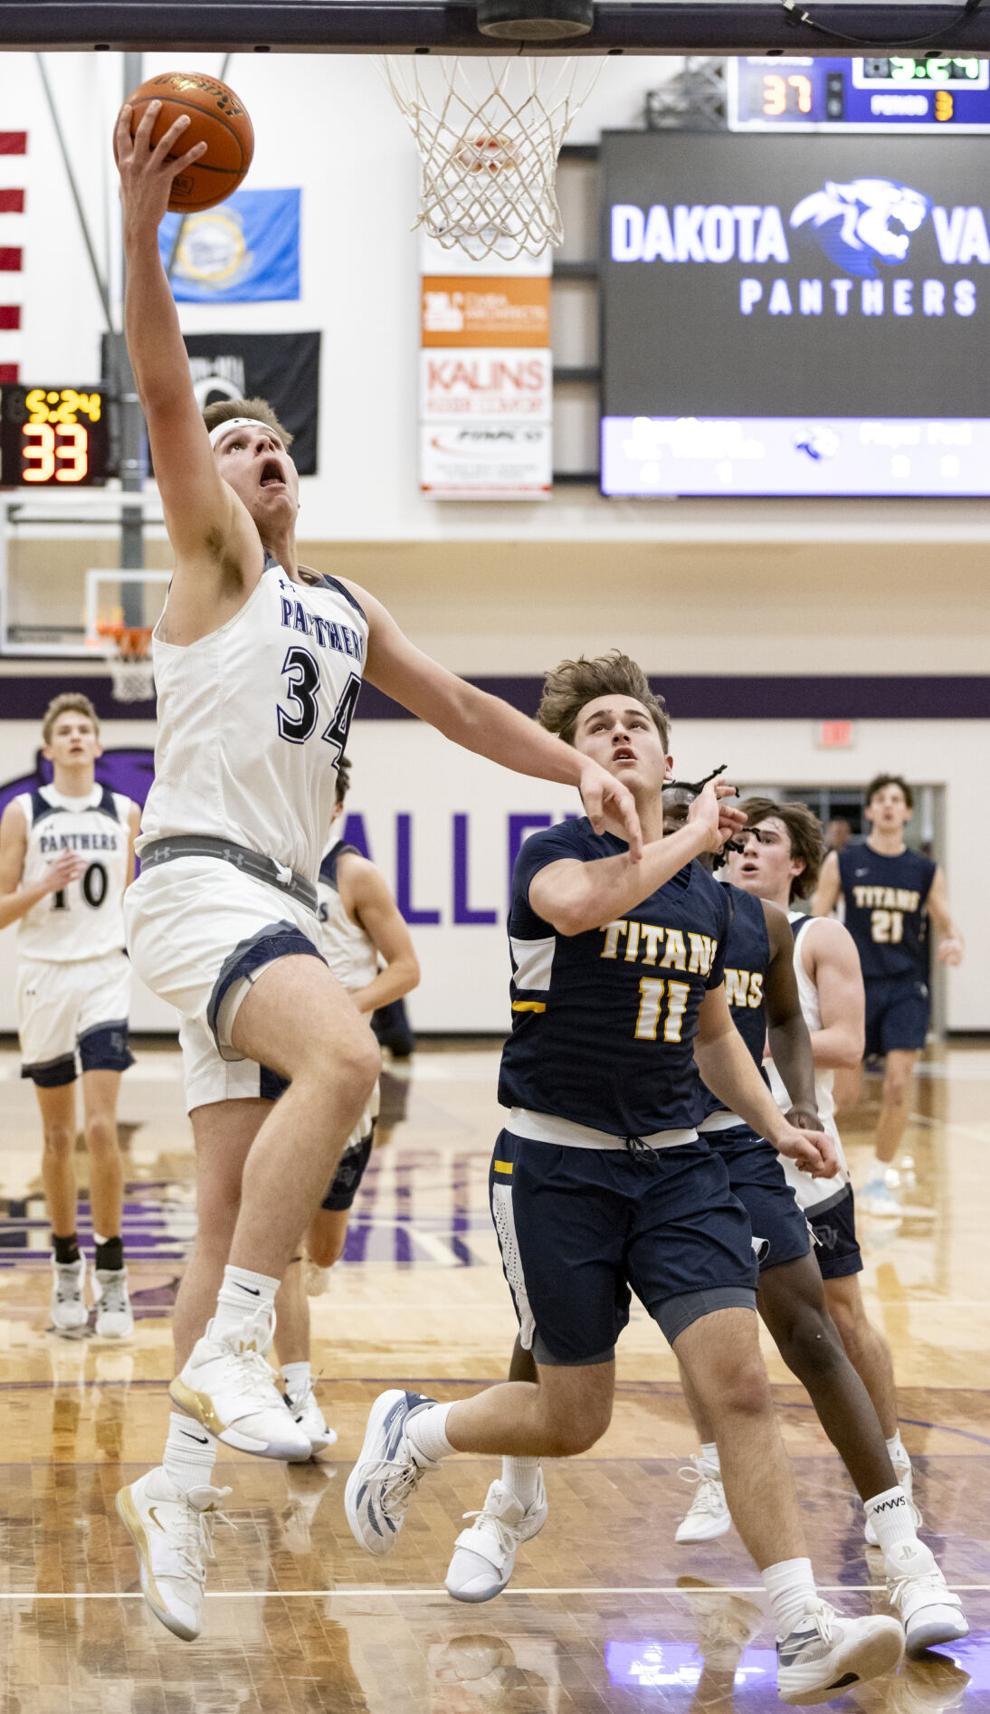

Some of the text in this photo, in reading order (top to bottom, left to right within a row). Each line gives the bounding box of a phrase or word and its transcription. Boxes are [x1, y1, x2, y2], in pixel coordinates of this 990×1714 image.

[762, 75, 812, 116] 37
[611, 204, 790, 263] DAKOTA
[739, 278, 977, 317] PANTHERS
[22, 423, 88, 482] 33
[280, 595, 364, 663] PATHER
[276, 645, 362, 770] 34
[40, 833, 118, 853] PANTHERS
[870, 910, 903, 944] 21
[634, 976, 691, 1043] 11
